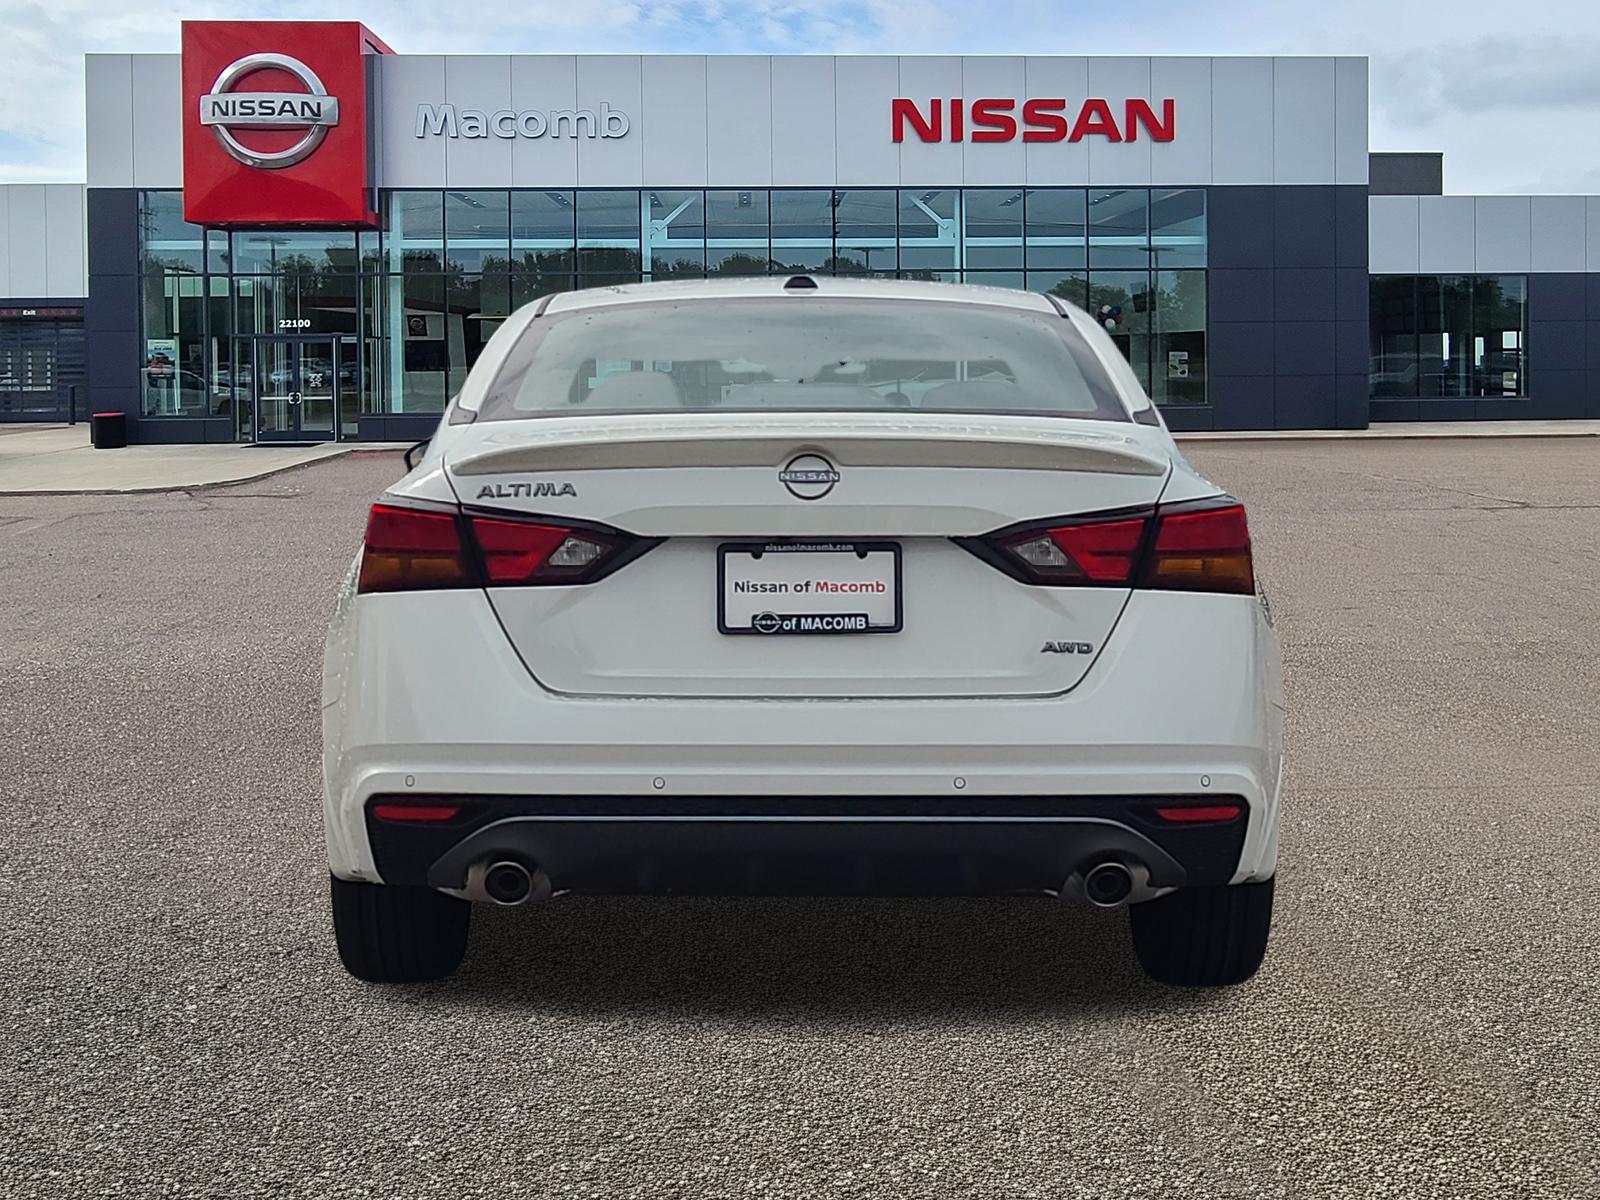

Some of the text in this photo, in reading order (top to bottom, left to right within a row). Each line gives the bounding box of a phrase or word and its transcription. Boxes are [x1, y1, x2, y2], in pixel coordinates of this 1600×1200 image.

[212, 100, 322, 117] NISSAN
[415, 102, 630, 139] Macomb
[892, 98, 1175, 143] NISSAN
[279, 319, 311, 328] 22100
[780, 472, 839, 480] NISSAN
[476, 482, 577, 499] ALTIMA
[734, 580, 886, 593] Nissan of Macomb
[782, 616, 866, 630] of MACOMB
[1040, 641, 1094, 654] AWD
